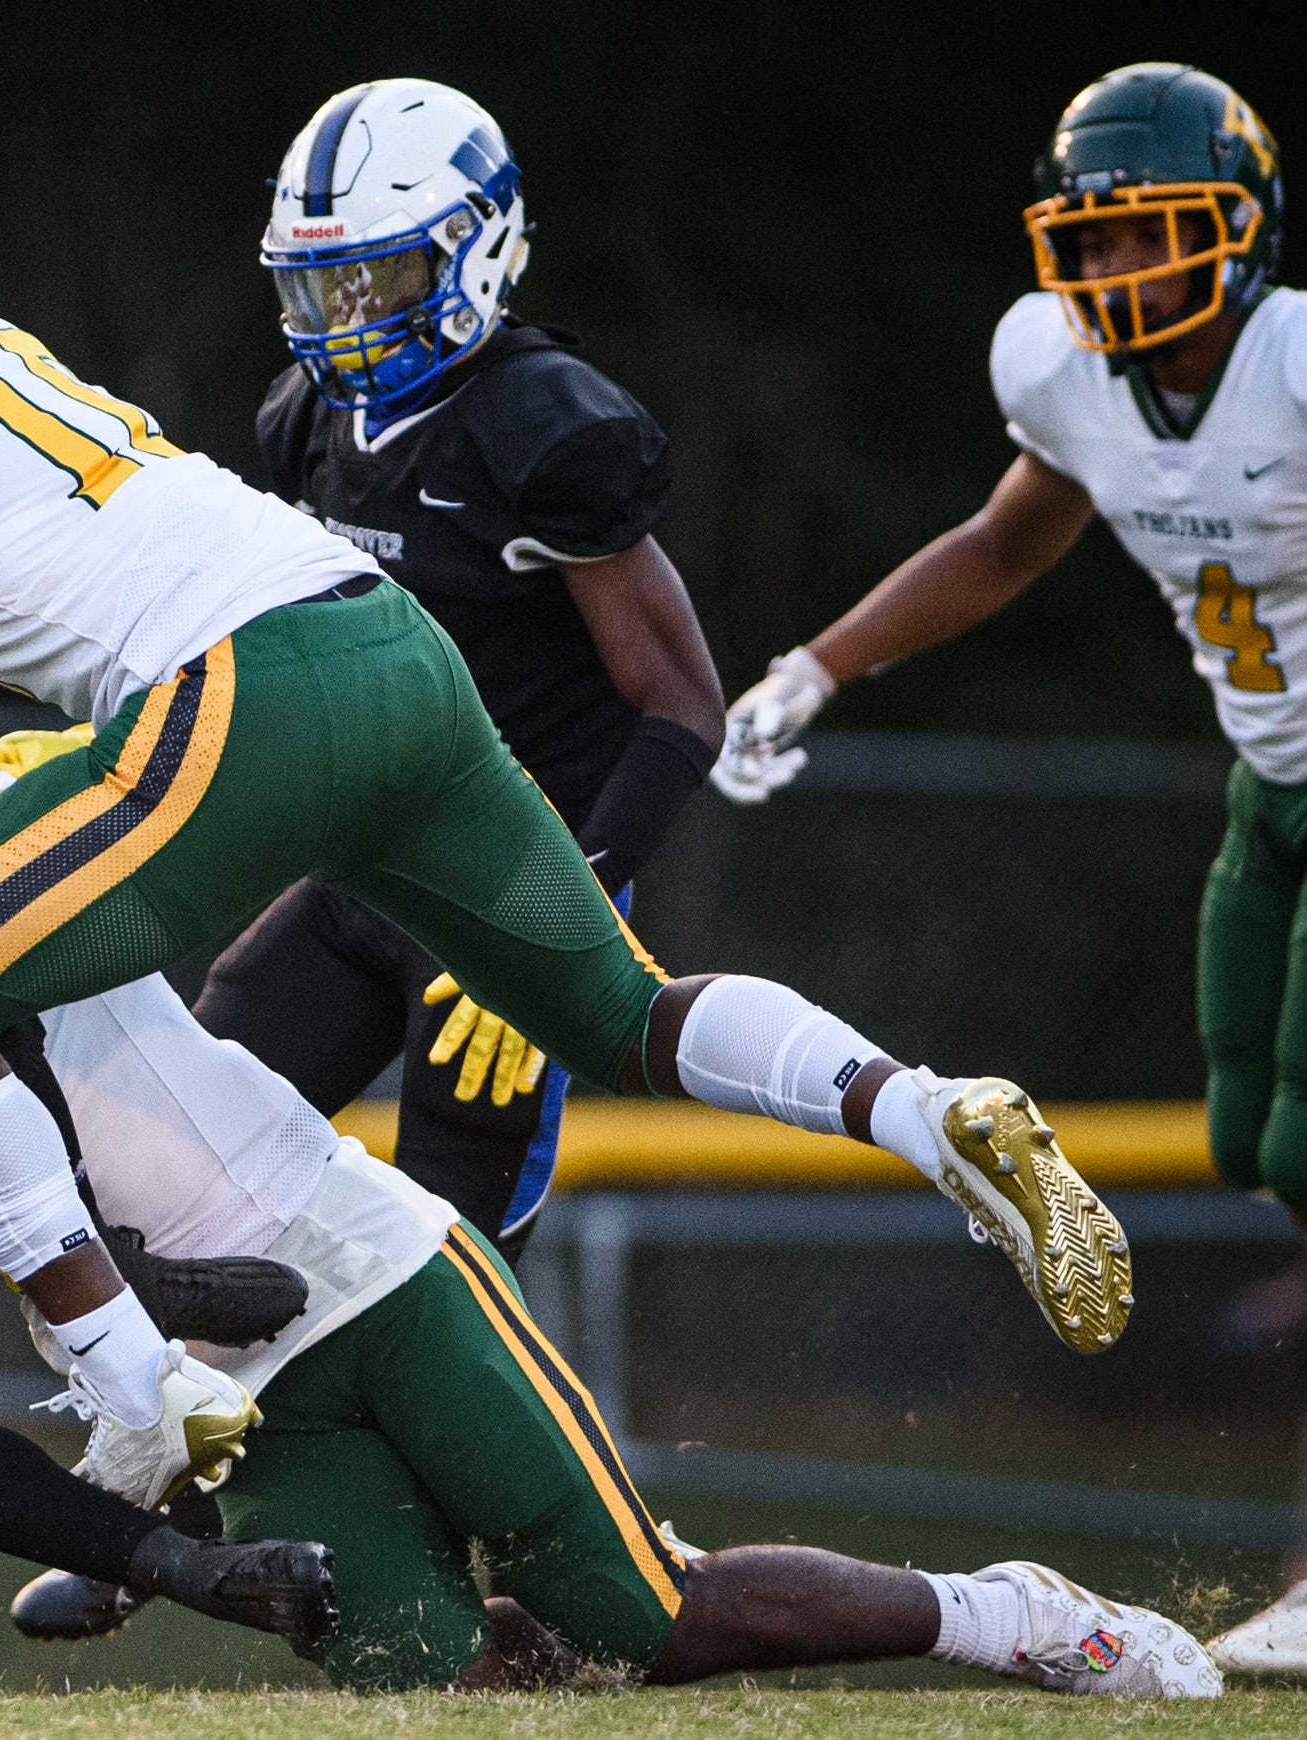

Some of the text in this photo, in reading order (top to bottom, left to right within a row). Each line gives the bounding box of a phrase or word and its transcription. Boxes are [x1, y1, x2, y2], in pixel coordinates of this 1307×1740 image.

[292, 224, 344, 238] Riddell
[1132, 509, 1233, 539] TROJANS
[1194, 559, 1288, 692] 4
